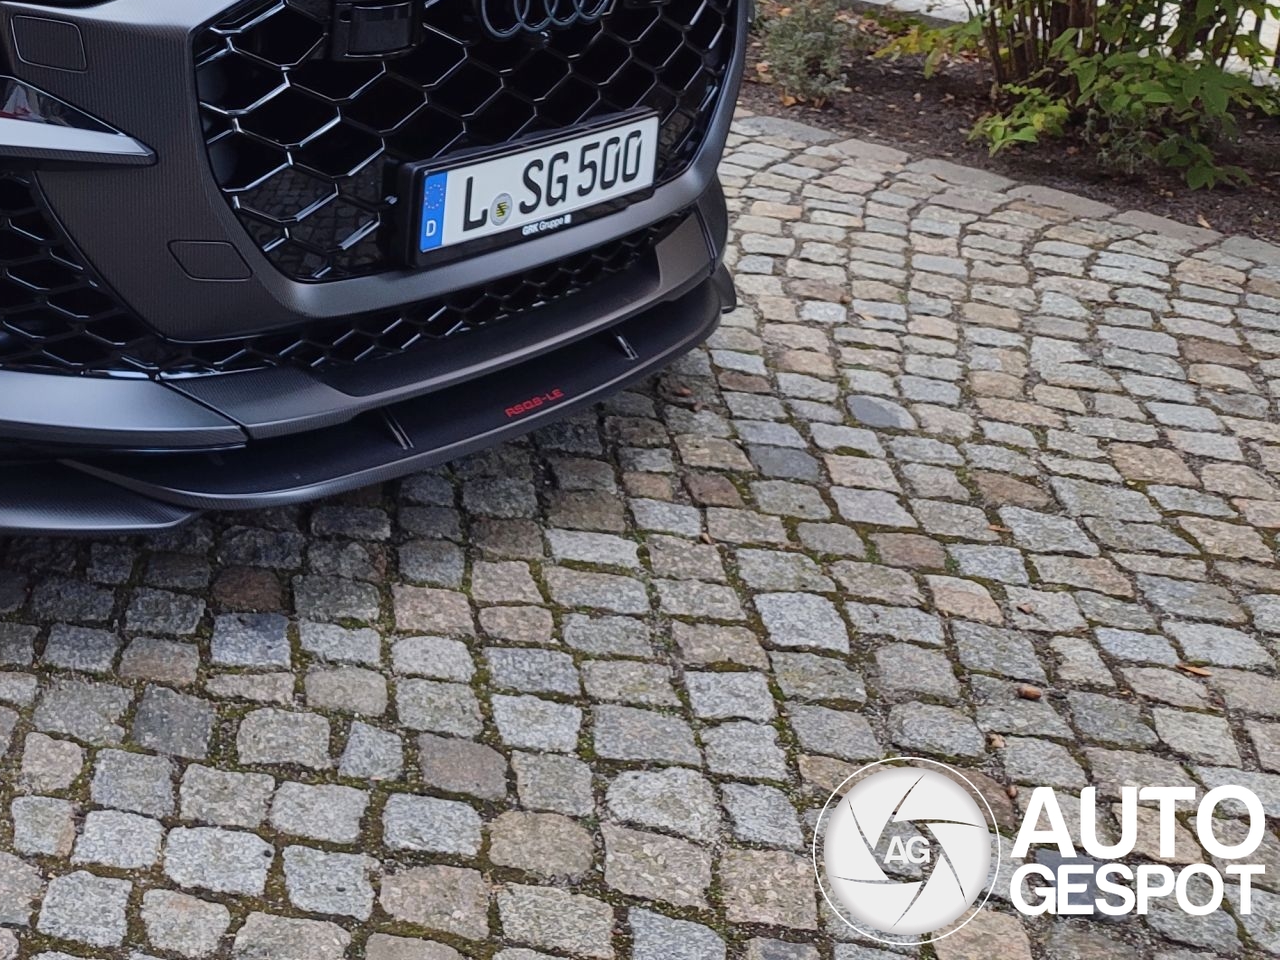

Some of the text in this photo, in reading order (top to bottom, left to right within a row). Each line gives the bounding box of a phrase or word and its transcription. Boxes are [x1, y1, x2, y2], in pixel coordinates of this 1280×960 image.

[463, 129, 642, 232] L SG 500
[425, 219, 437, 237] D
[522, 217, 564, 236] GRK Gruppe
